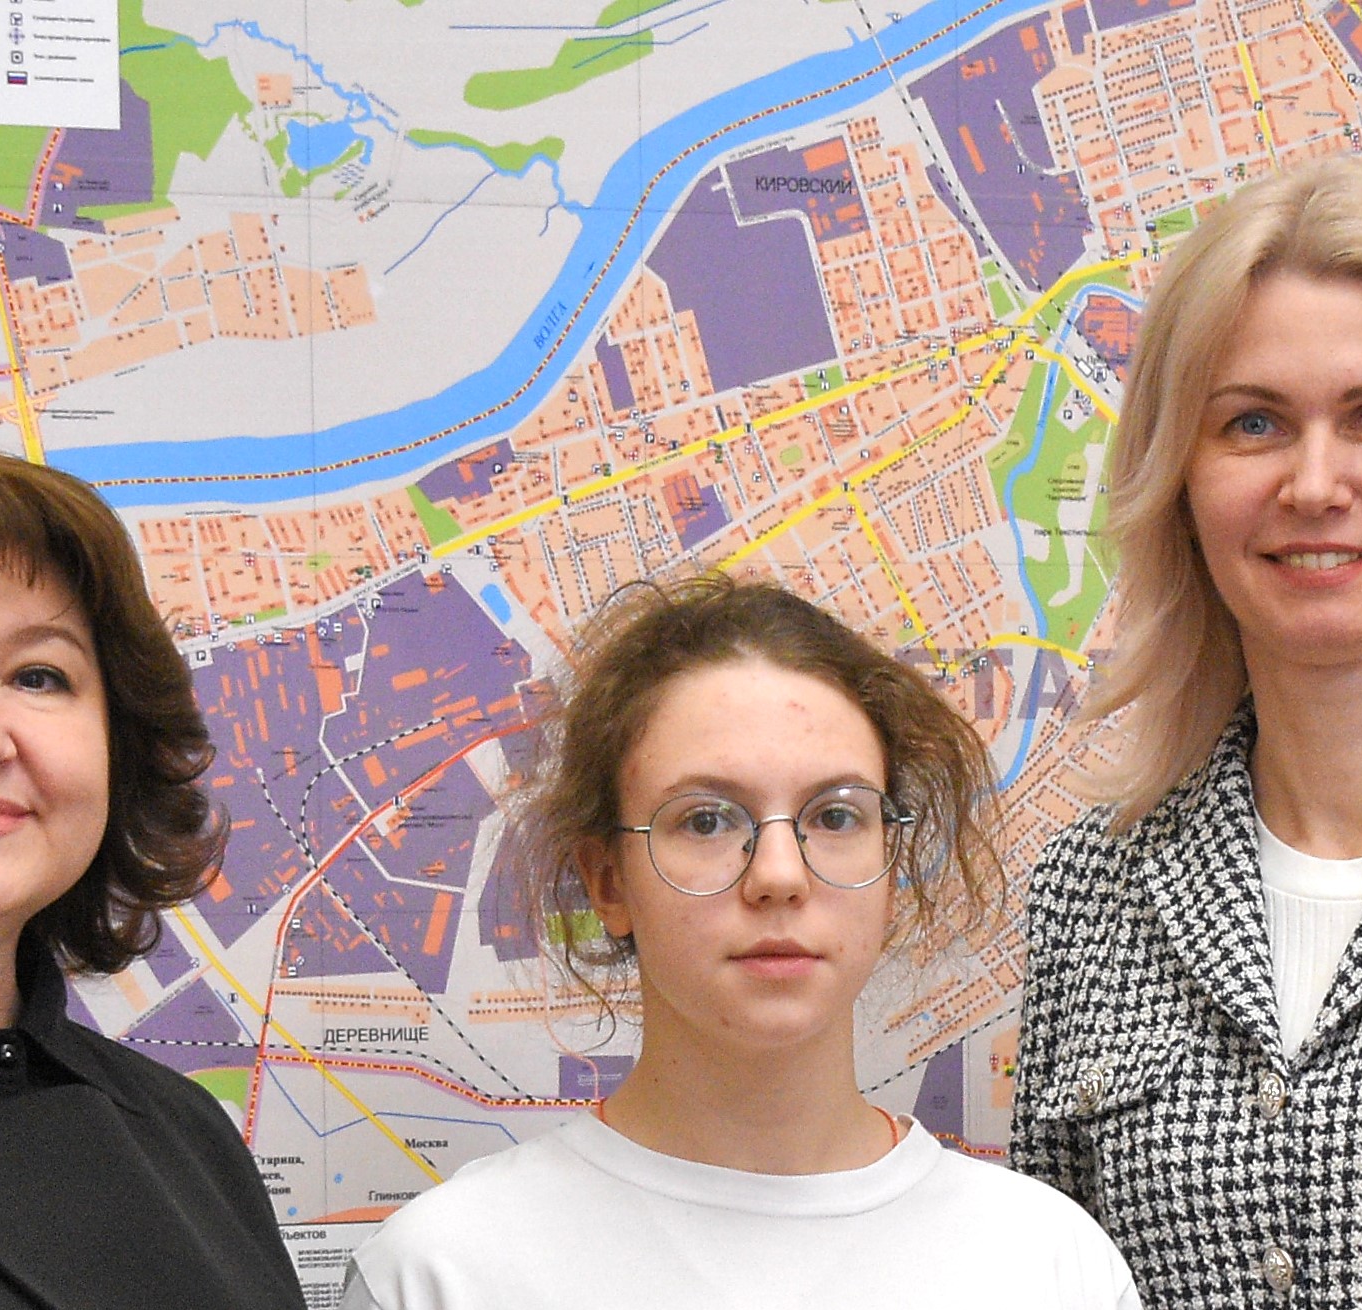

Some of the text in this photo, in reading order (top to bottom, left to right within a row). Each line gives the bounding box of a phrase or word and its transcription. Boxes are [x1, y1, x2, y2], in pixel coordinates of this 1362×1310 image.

[755, 175, 853, 196] КИРОВСКИЙ
[533, 300, 568, 351] ВОЛГА
[323, 1027, 430, 1046] ДЕРЕВНИЩЕ
[404, 1138, 449, 1149] Москва
